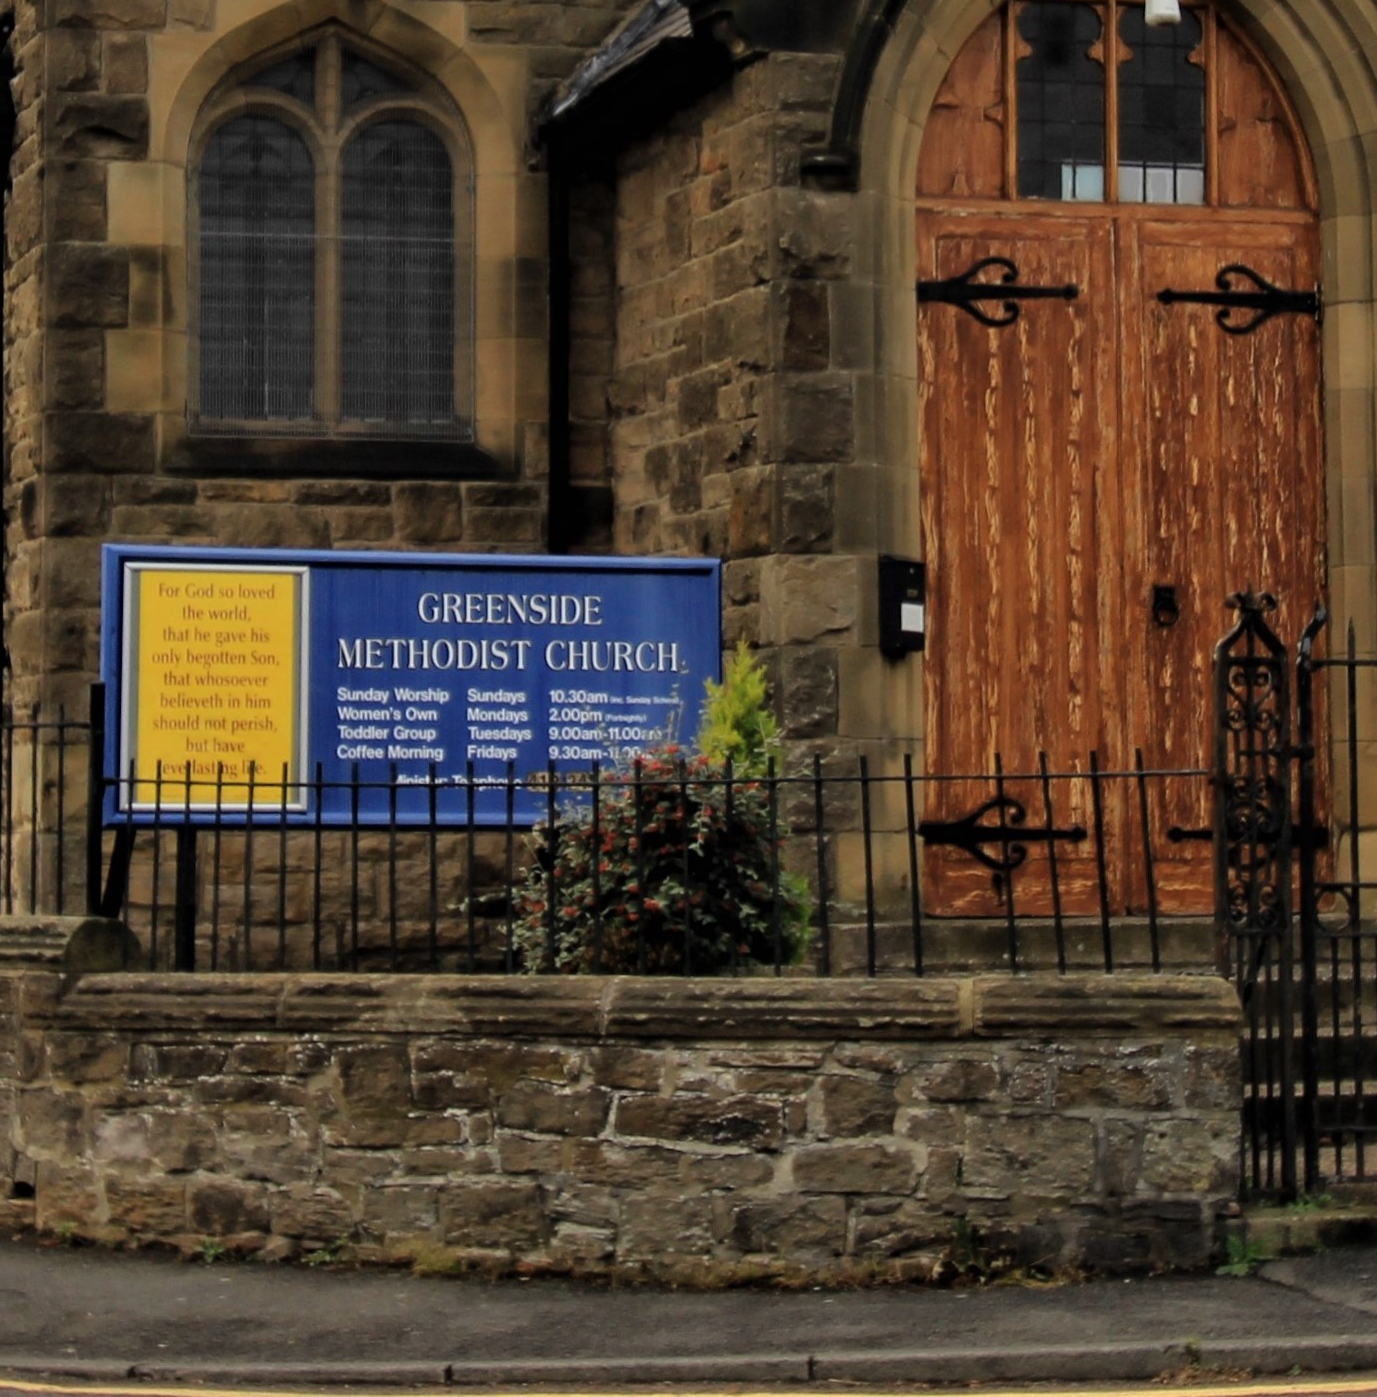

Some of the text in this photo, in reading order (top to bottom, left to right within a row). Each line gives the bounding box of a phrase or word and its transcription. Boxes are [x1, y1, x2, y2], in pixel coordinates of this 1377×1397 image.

[159, 583, 275, 599] For God so loved
[183, 605, 251, 622] the world,
[418, 592, 603, 625] GREENSIDE
[163, 626, 270, 647] that he gave his
[152, 648, 280, 669] only begotten Son,
[337, 638, 679, 672] METHODIST CHURCH
[164, 670, 268, 687] that whosoever
[160, 693, 271, 709] believeth in him
[337, 687, 389, 703] Sunday
[394, 688, 450, 704] Worship
[467, 689, 526, 705] Sundays
[549, 689, 608, 703] 10.30am
[626, 695, 651, 705] Sunday
[338, 707, 647, 724] Women's Own Mondays 2.00pm (Fortnightly)
[153, 714, 277, 735] should not perish,
[338, 726, 389, 739] Toddler
[393, 726, 436, 741] Group
[468, 727, 532, 742] Tuesdays
[186, 737, 245, 753] but have
[337, 745, 383, 759] Coffee
[388, 745, 444, 761] Morning
[467, 745, 517, 761] Fridays
[163, 760, 267, 779] evelastng lie.
[452, 774, 523, 791] Teephoe
